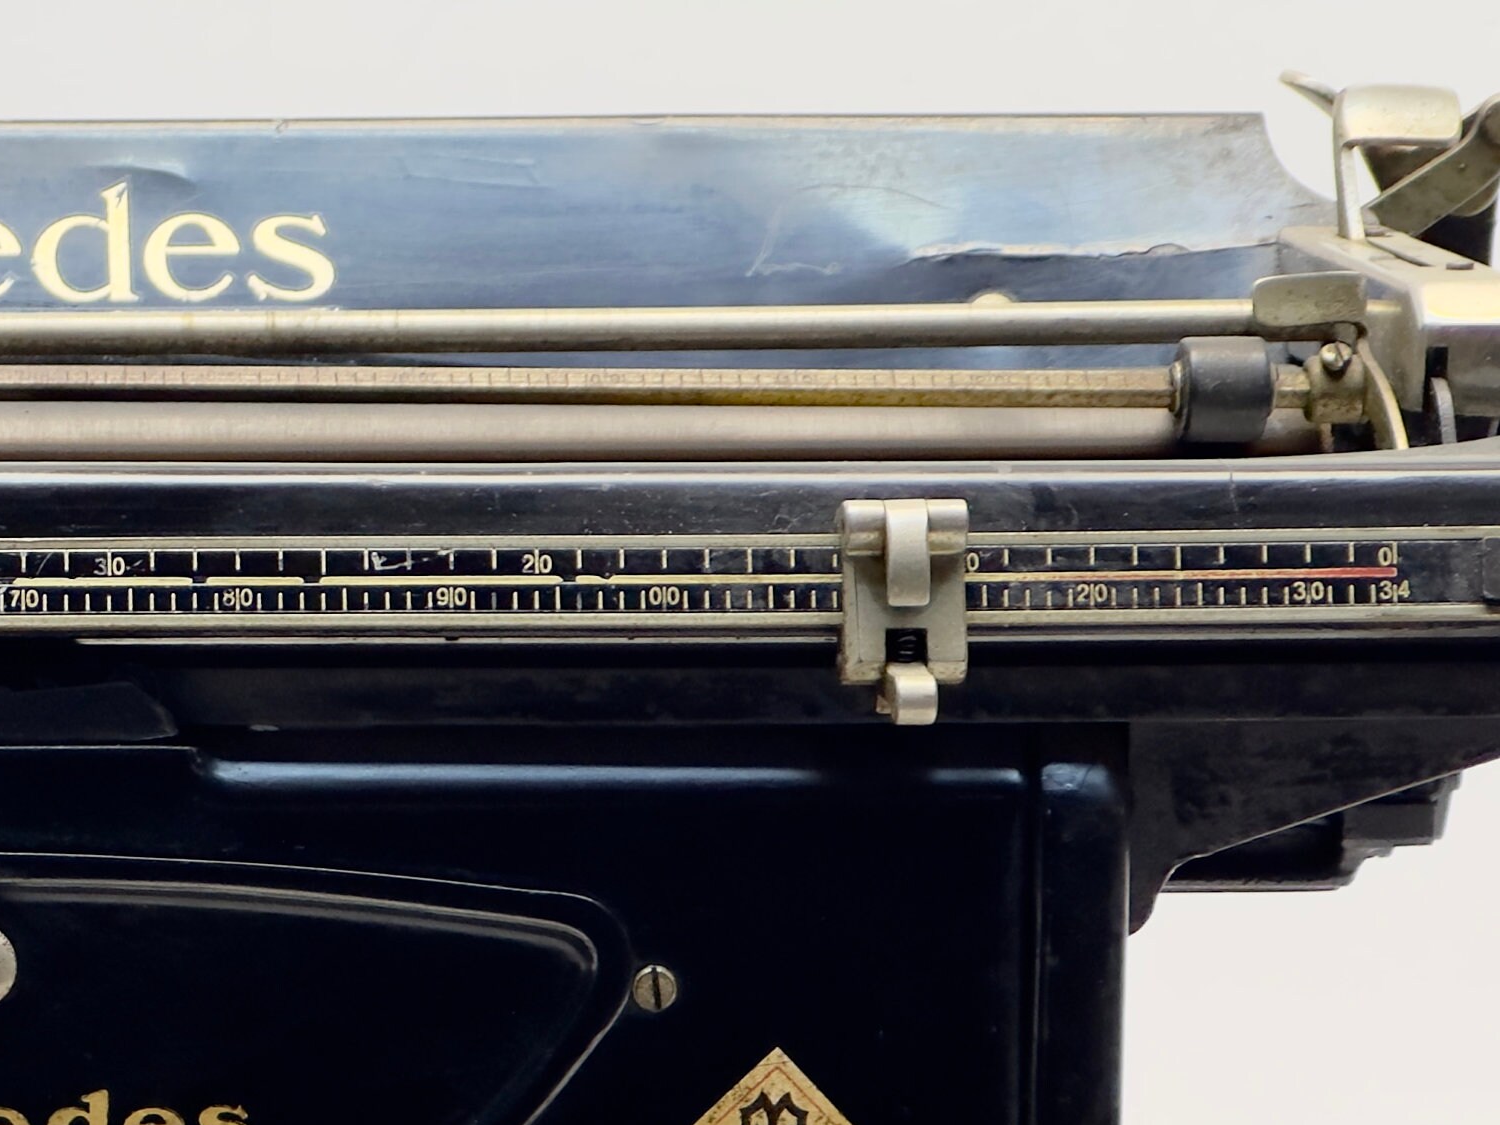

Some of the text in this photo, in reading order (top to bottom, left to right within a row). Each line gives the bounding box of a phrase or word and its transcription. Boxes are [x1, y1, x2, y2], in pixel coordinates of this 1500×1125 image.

[94, 556, 125, 576] 30
[522, 553, 552, 573] 20
[10, 588, 39, 608] 70
[222, 588, 253, 607] 80
[436, 586, 467, 606] 90
[1076, 583, 1108, 602] 20
[1293, 580, 1324, 599] 30
[1379, 580, 1411, 599] 34
